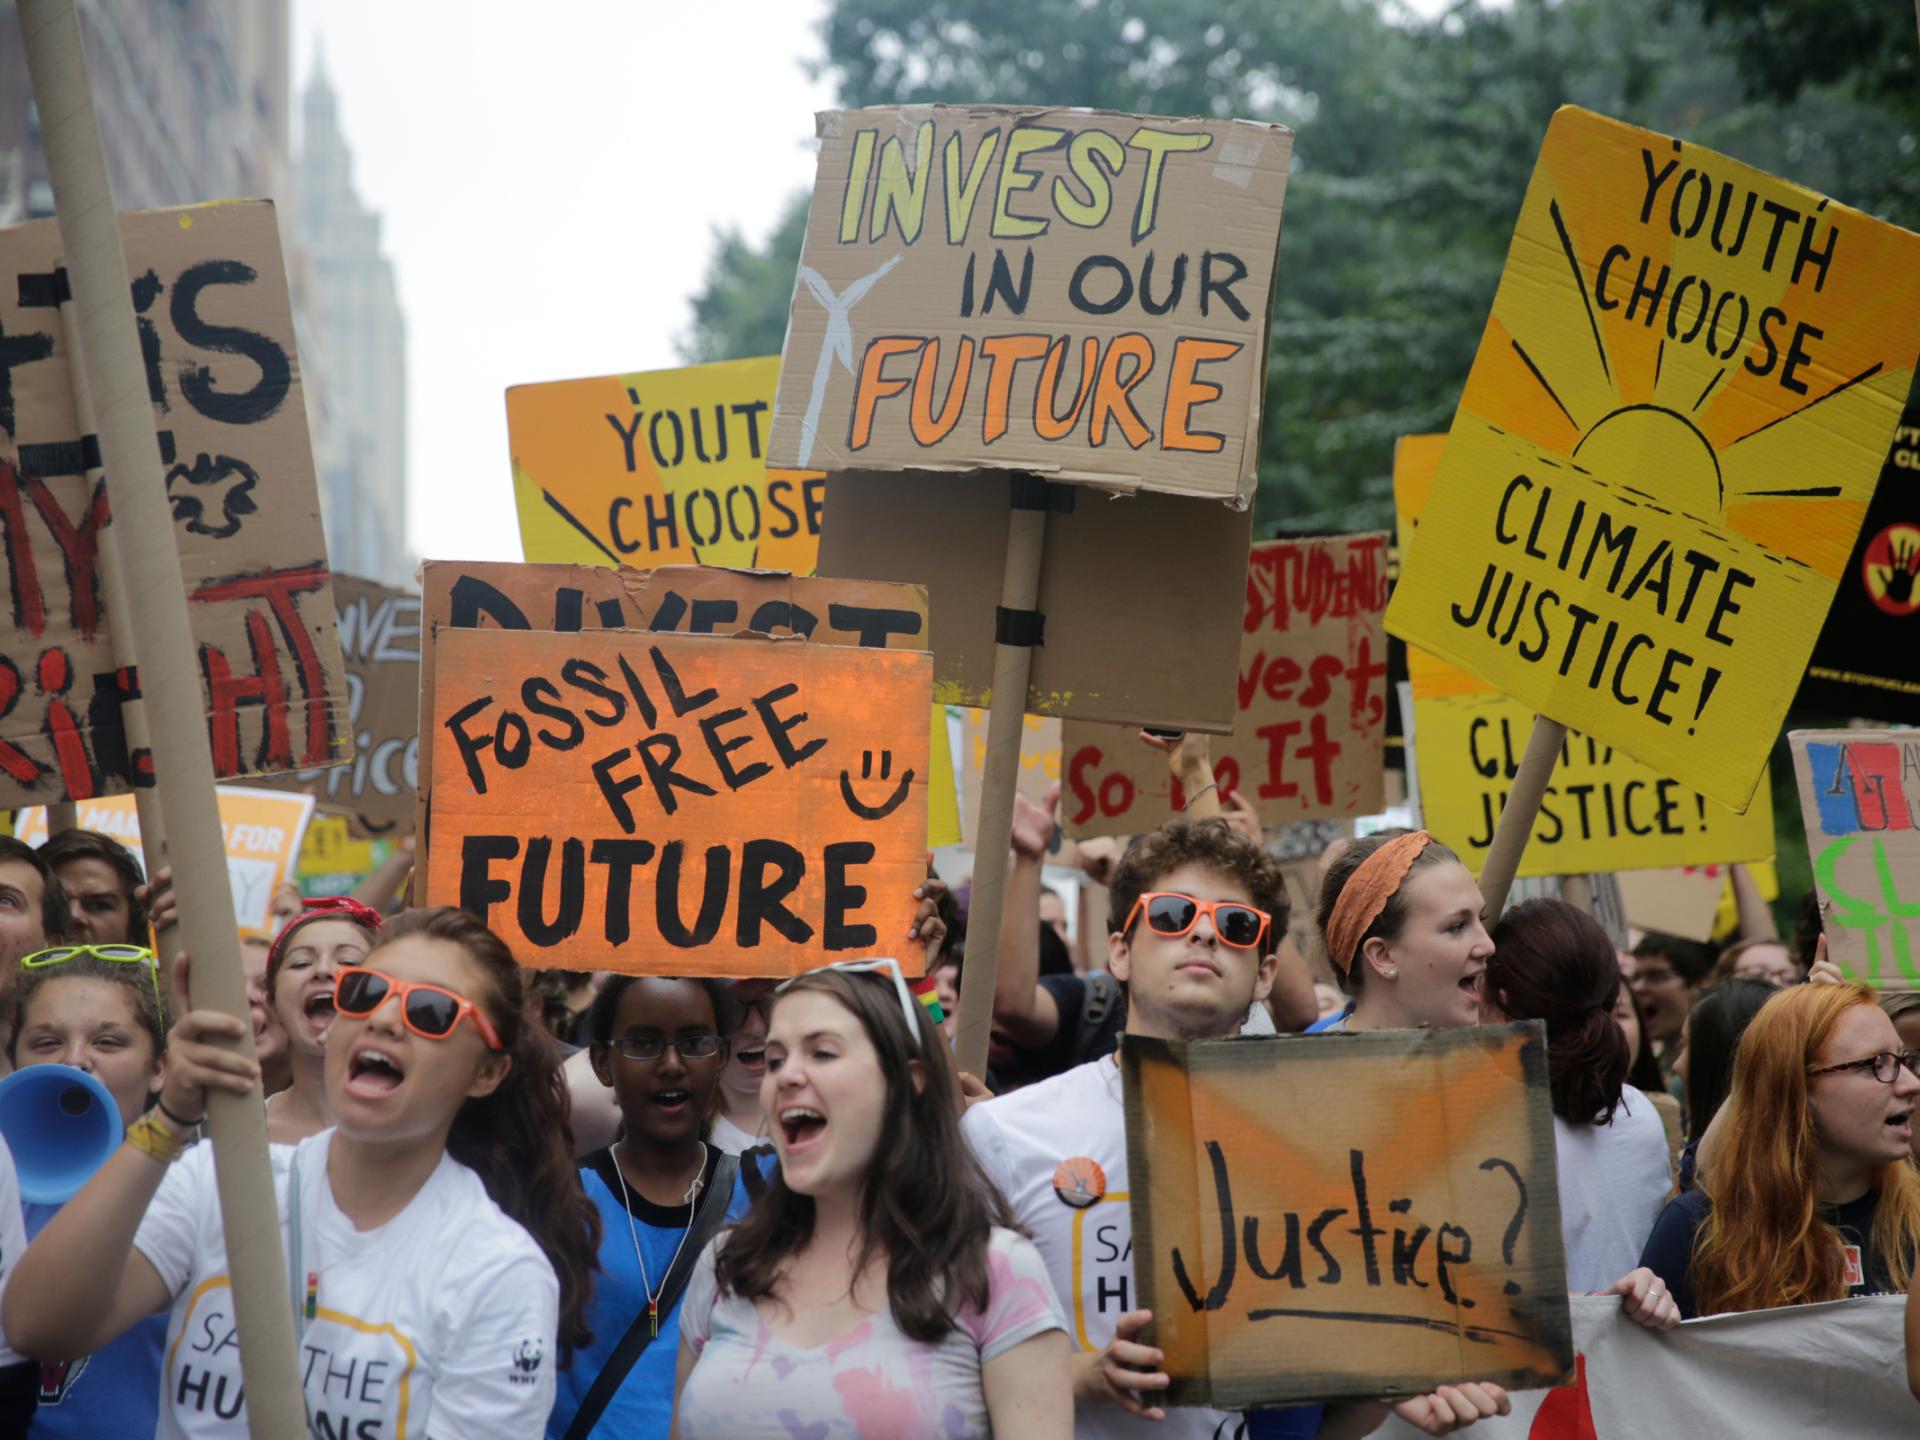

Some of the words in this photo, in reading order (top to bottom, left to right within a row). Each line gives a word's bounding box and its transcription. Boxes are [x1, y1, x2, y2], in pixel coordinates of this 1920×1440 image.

[839, 119, 1213, 246] INVEST
[1641, 148, 1839, 293] YOUTH
[960, 247, 1034, 317] IN
[1068, 250, 1250, 321] OUR
[1595, 244, 1824, 396] CHOOSE
[606, 401, 768, 472] YOUT
[846, 332, 1244, 452] FUTURE
[609, 478, 826, 553] CHOOSE
[1495, 475, 1756, 646] CLIMATE
[1451, 563, 1722, 736] JUSTICE!
[591, 683, 828, 834] FREE
[1068, 745, 1135, 825] So
[231, 824, 285, 855] FOR
[459, 835, 877, 950] FUTURE
[304, 1345, 388, 1404] THE
